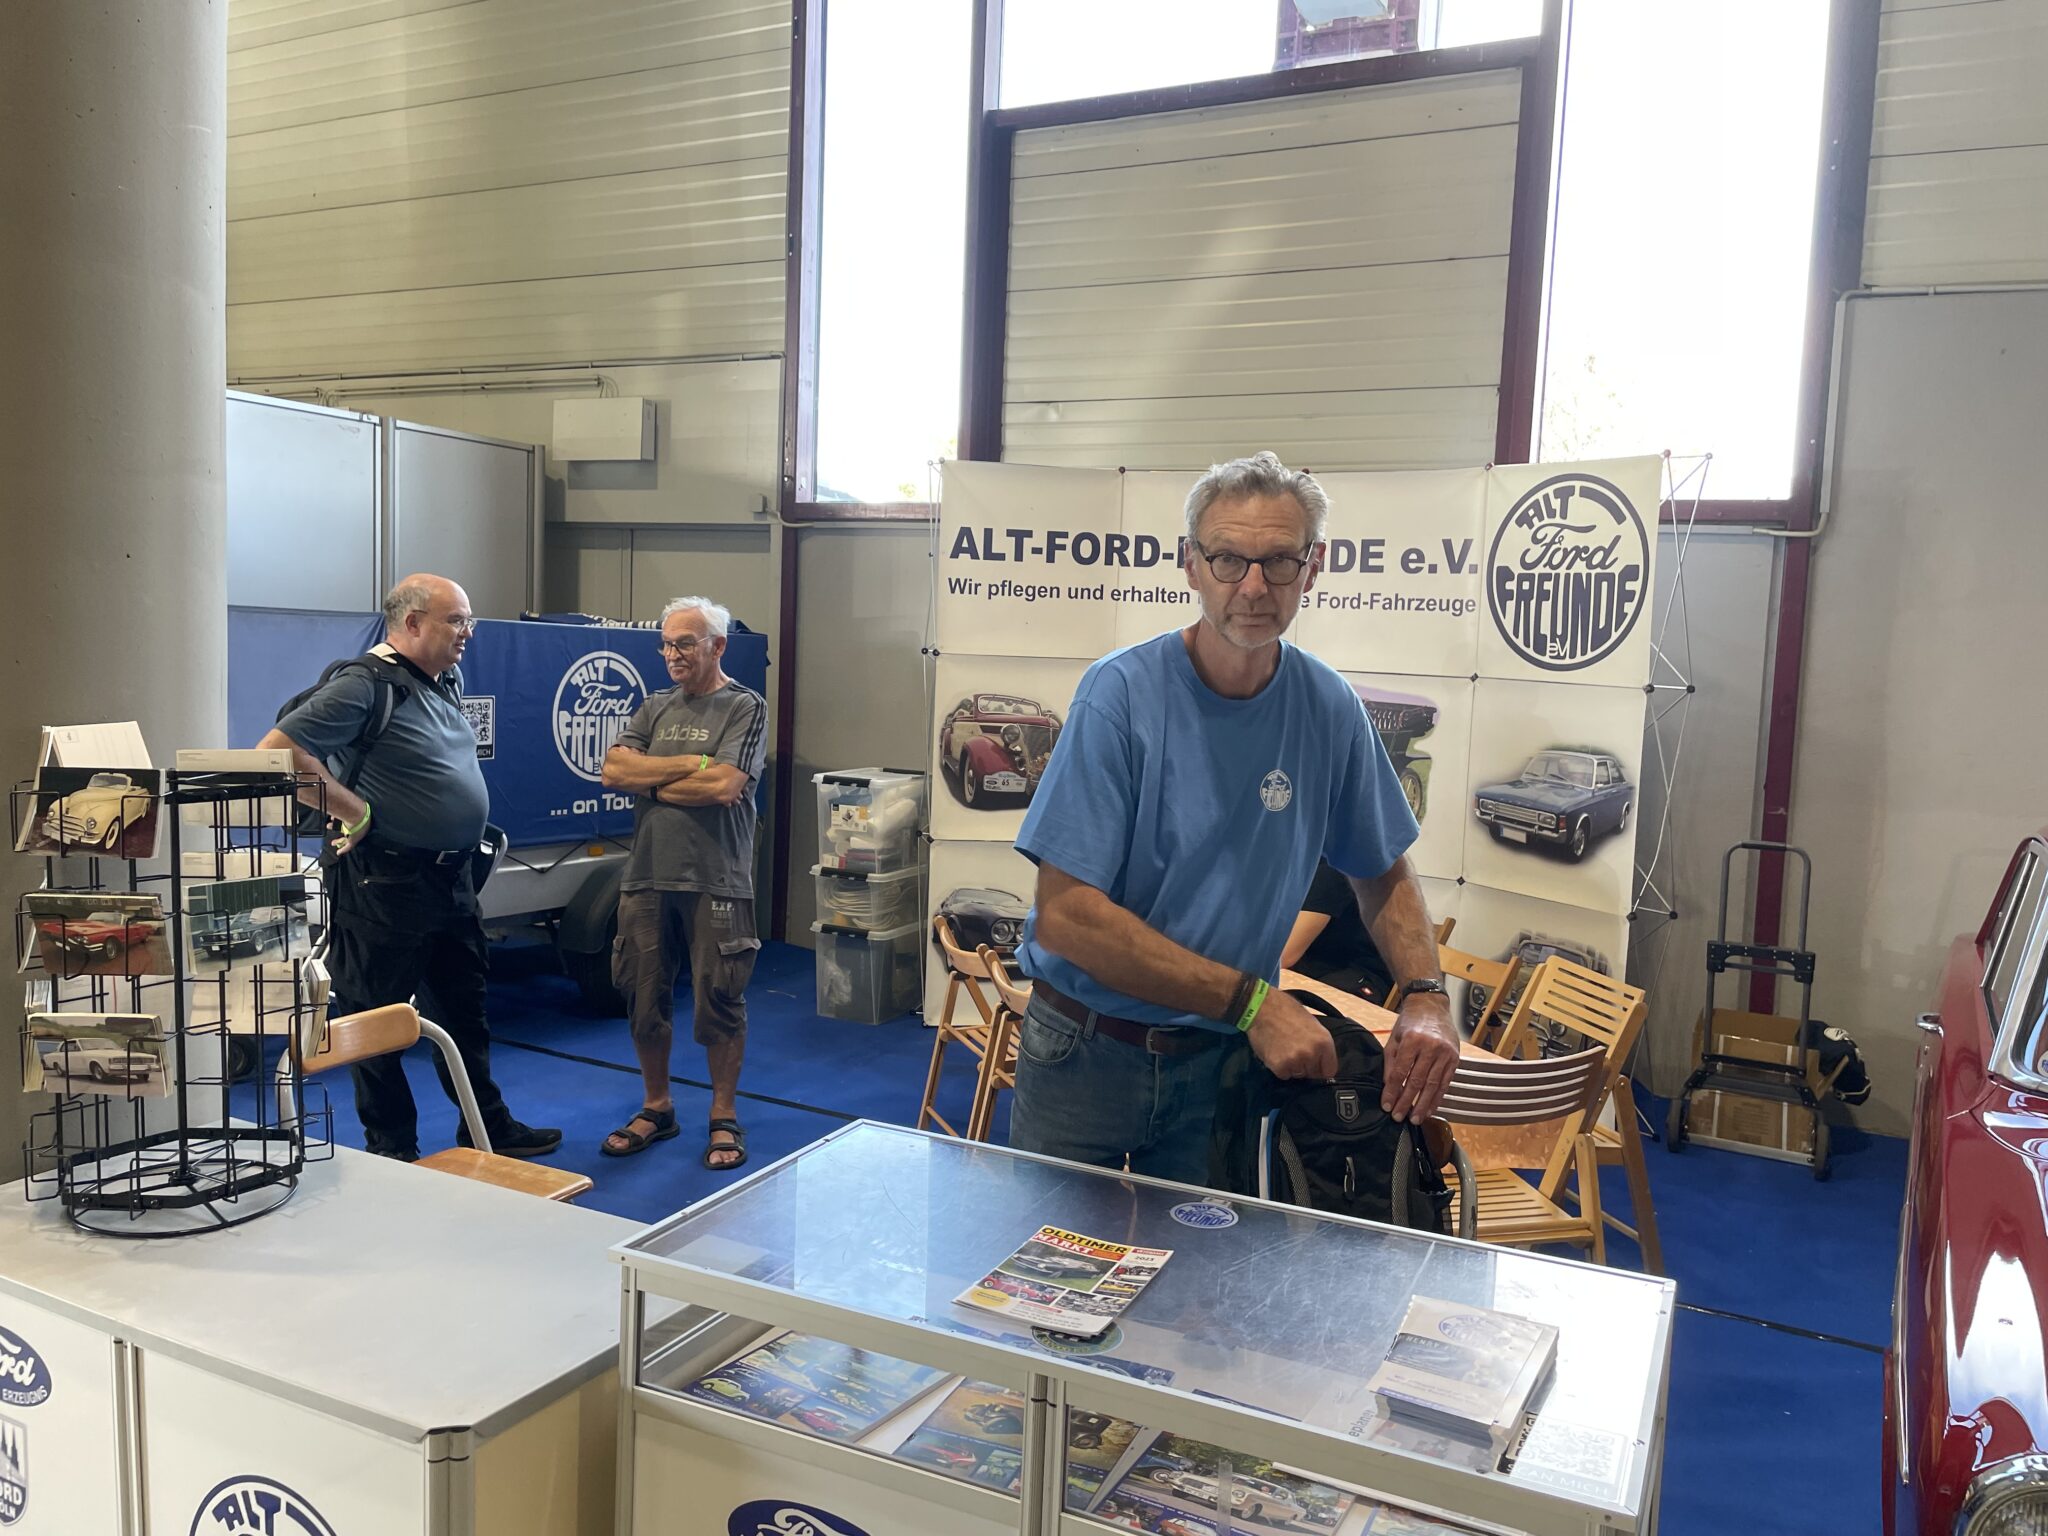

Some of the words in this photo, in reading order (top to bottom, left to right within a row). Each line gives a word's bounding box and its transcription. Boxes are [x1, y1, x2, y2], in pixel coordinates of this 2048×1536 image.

[1515, 485, 1576, 530] ALT
[1400, 538, 1479, 574] e.V.
[1519, 522, 1622, 571] Ford
[948, 577, 982, 595] Wir
[987, 580, 1061, 602] pflegen
[1067, 584, 1105, 601] und
[1110, 585, 1191, 604] erhalten
[1316, 591, 1477, 617] Ford-Fahrzeuge
[1496, 564, 1640, 660] FREUNDE
[570, 659, 608, 687] ALT
[573, 682, 634, 715] Ford
[656, 724, 710, 741] adidas
[572, 799, 598, 814] on
[601, 793, 635, 811] Tou
[1033, 1233, 1093, 1254] MARKT
[1042, 1227, 1128, 1254] OLDTIMER
[212, 1490, 282, 1536] ALT
